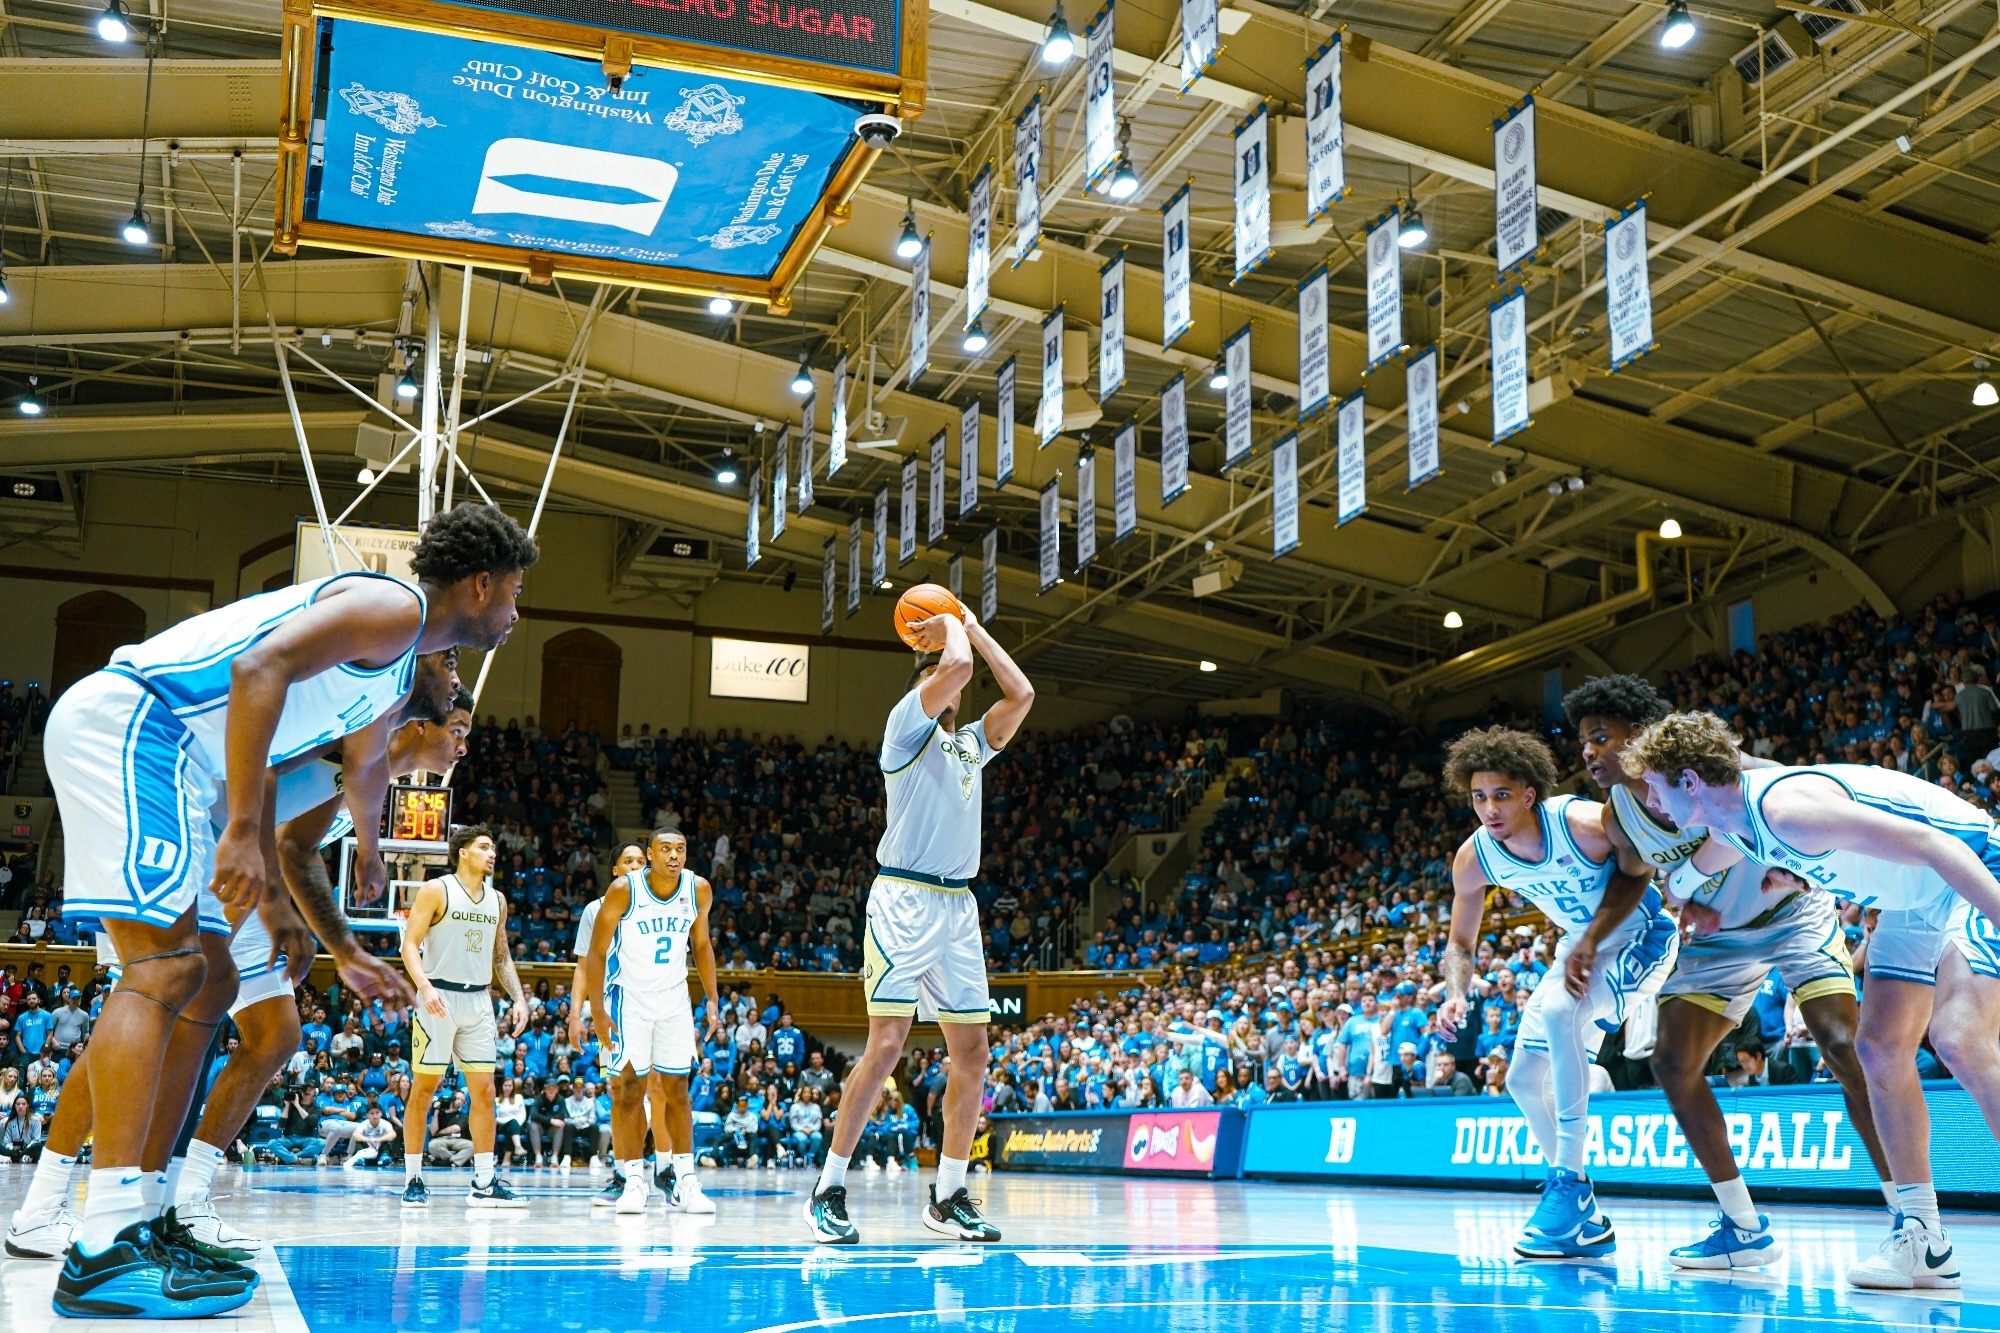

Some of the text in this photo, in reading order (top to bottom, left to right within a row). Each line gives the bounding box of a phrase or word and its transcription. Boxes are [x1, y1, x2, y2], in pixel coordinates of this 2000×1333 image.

[747, 0, 875, 42] SUGAR
[526, 71, 581, 96] Golf
[584, 85, 607, 100] &
[452, 75, 654, 125] Washington Duke
[730, 152, 786, 225] Washington Duke
[506, 231, 680, 259] Washington Duke
[355, 533, 420, 551] KRZYZEWS
[765, 656, 806, 678] 100
[407, 791, 446, 810] 6:46
[1513, 875, 1597, 898] DUKE
[451, 910, 498, 926] QUEENS
[1553, 895, 1595, 924] 5
[636, 916, 692, 936] DUKE
[464, 928, 483, 953] 12
[654, 936, 673, 965] 2
[1451, 1111, 1852, 1171] DUKE ASKEBALL
